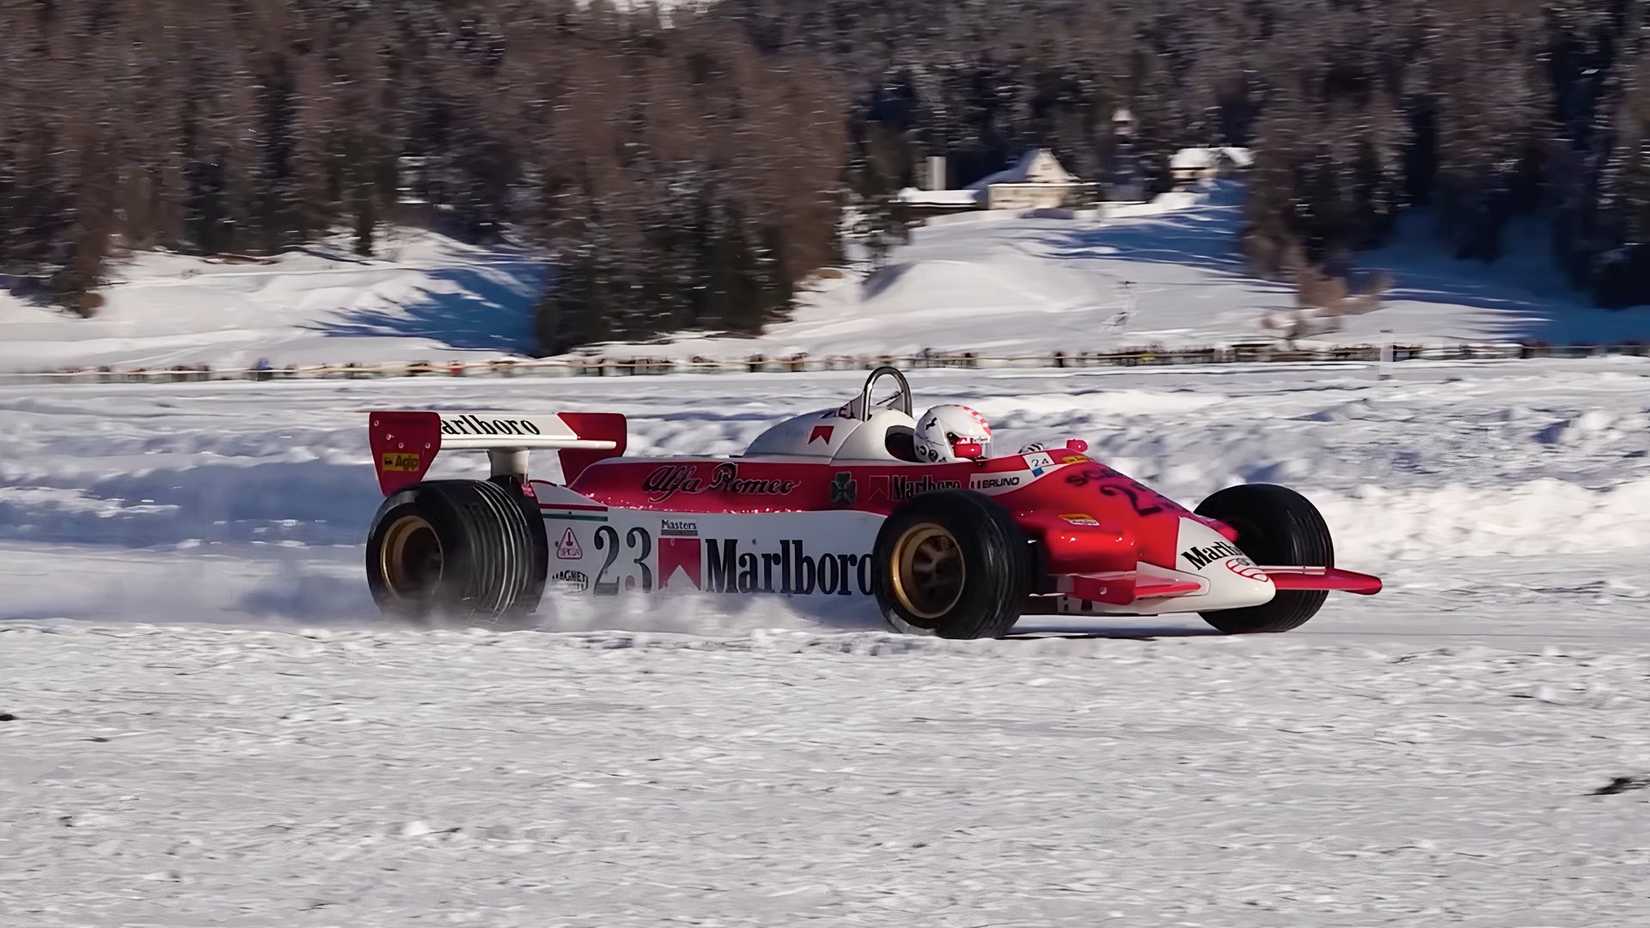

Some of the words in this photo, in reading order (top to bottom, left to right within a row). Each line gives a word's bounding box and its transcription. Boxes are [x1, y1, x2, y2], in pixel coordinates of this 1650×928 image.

[440, 414, 541, 435] arlboro
[642, 464, 702, 503] Alfa
[703, 462, 802, 496] Romeo
[661, 519, 697, 530] Masters
[593, 525, 652, 595] 23
[705, 538, 875, 596] Marlboro
